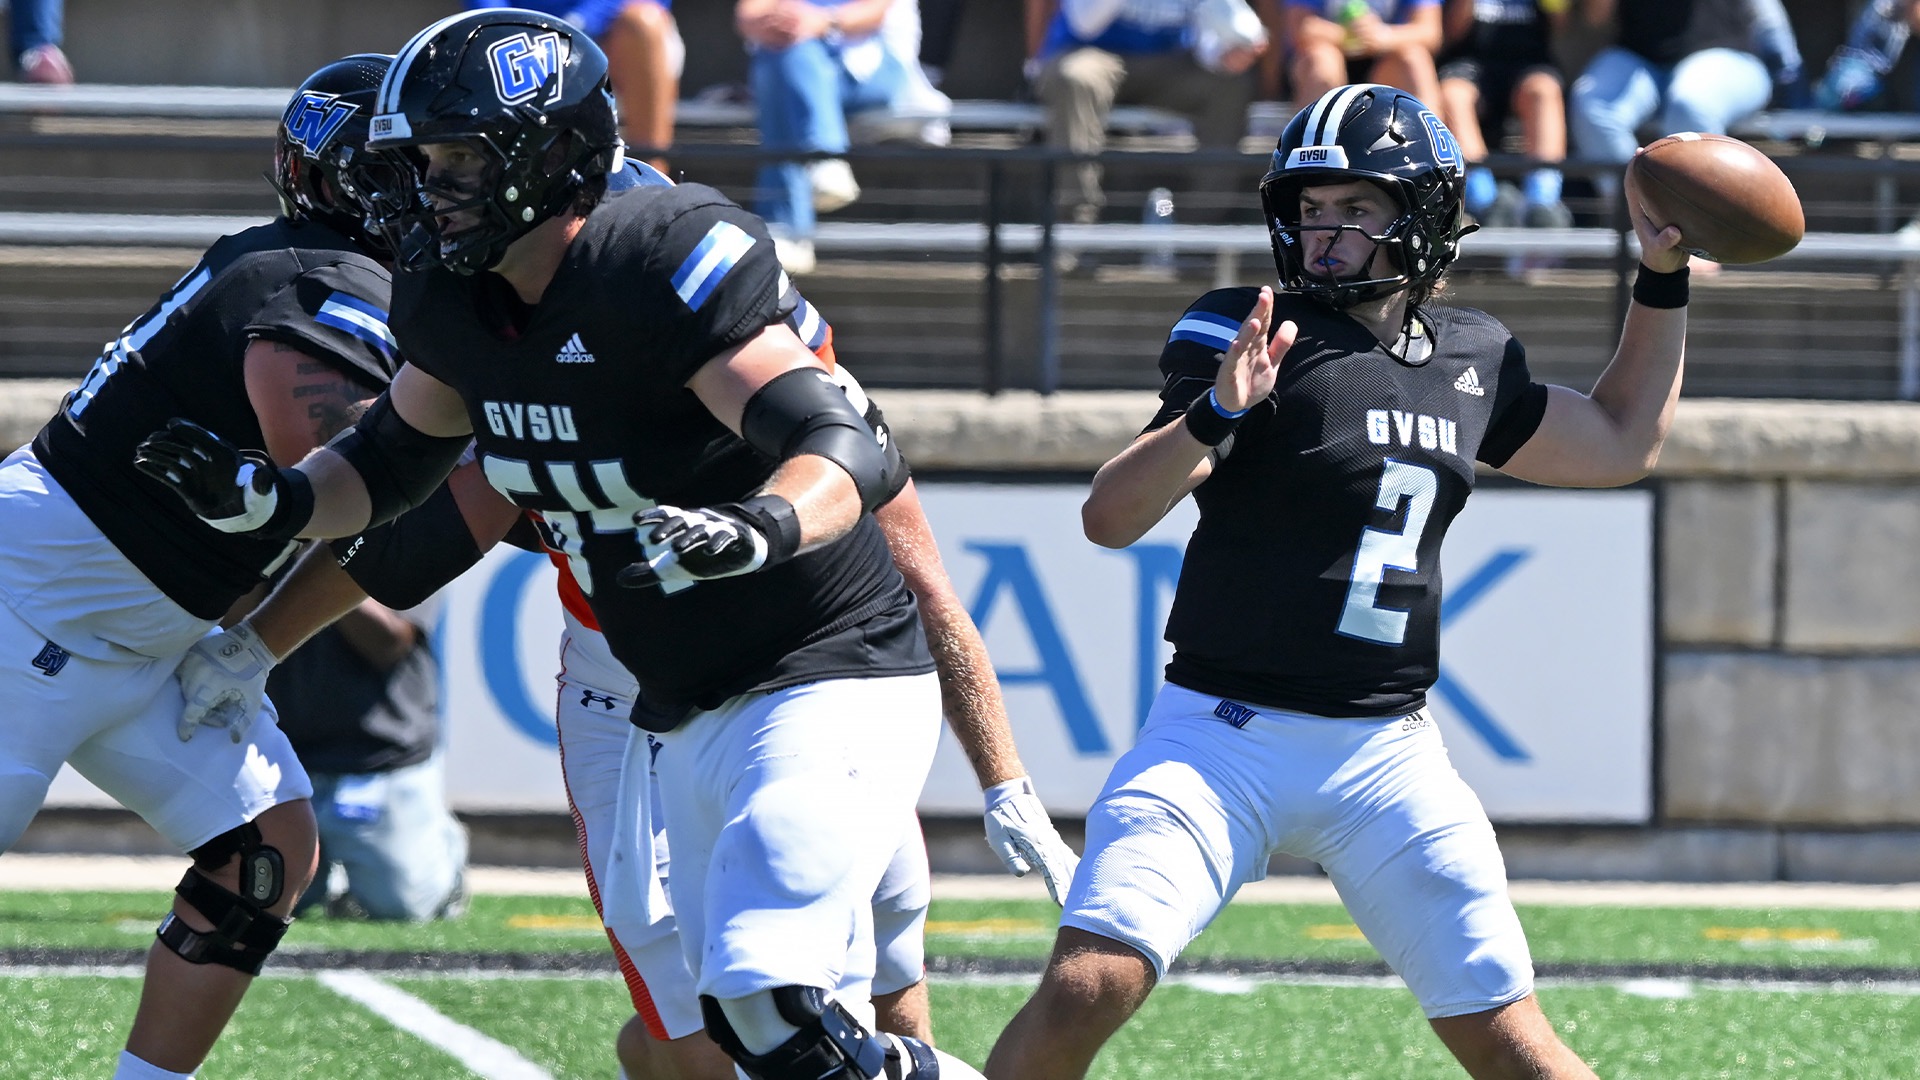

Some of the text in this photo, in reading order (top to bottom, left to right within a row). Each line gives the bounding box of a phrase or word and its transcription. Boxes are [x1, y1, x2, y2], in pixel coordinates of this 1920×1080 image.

[487, 31, 563, 106] GV
[284, 90, 361, 160] GV
[1299, 149, 1328, 162] GVSU
[556, 353, 595, 363] adidas
[1454, 380, 1485, 397] adidas
[483, 400, 579, 442] GVSU
[1366, 408, 1458, 456] GVSU
[1334, 456, 1439, 647] 2
